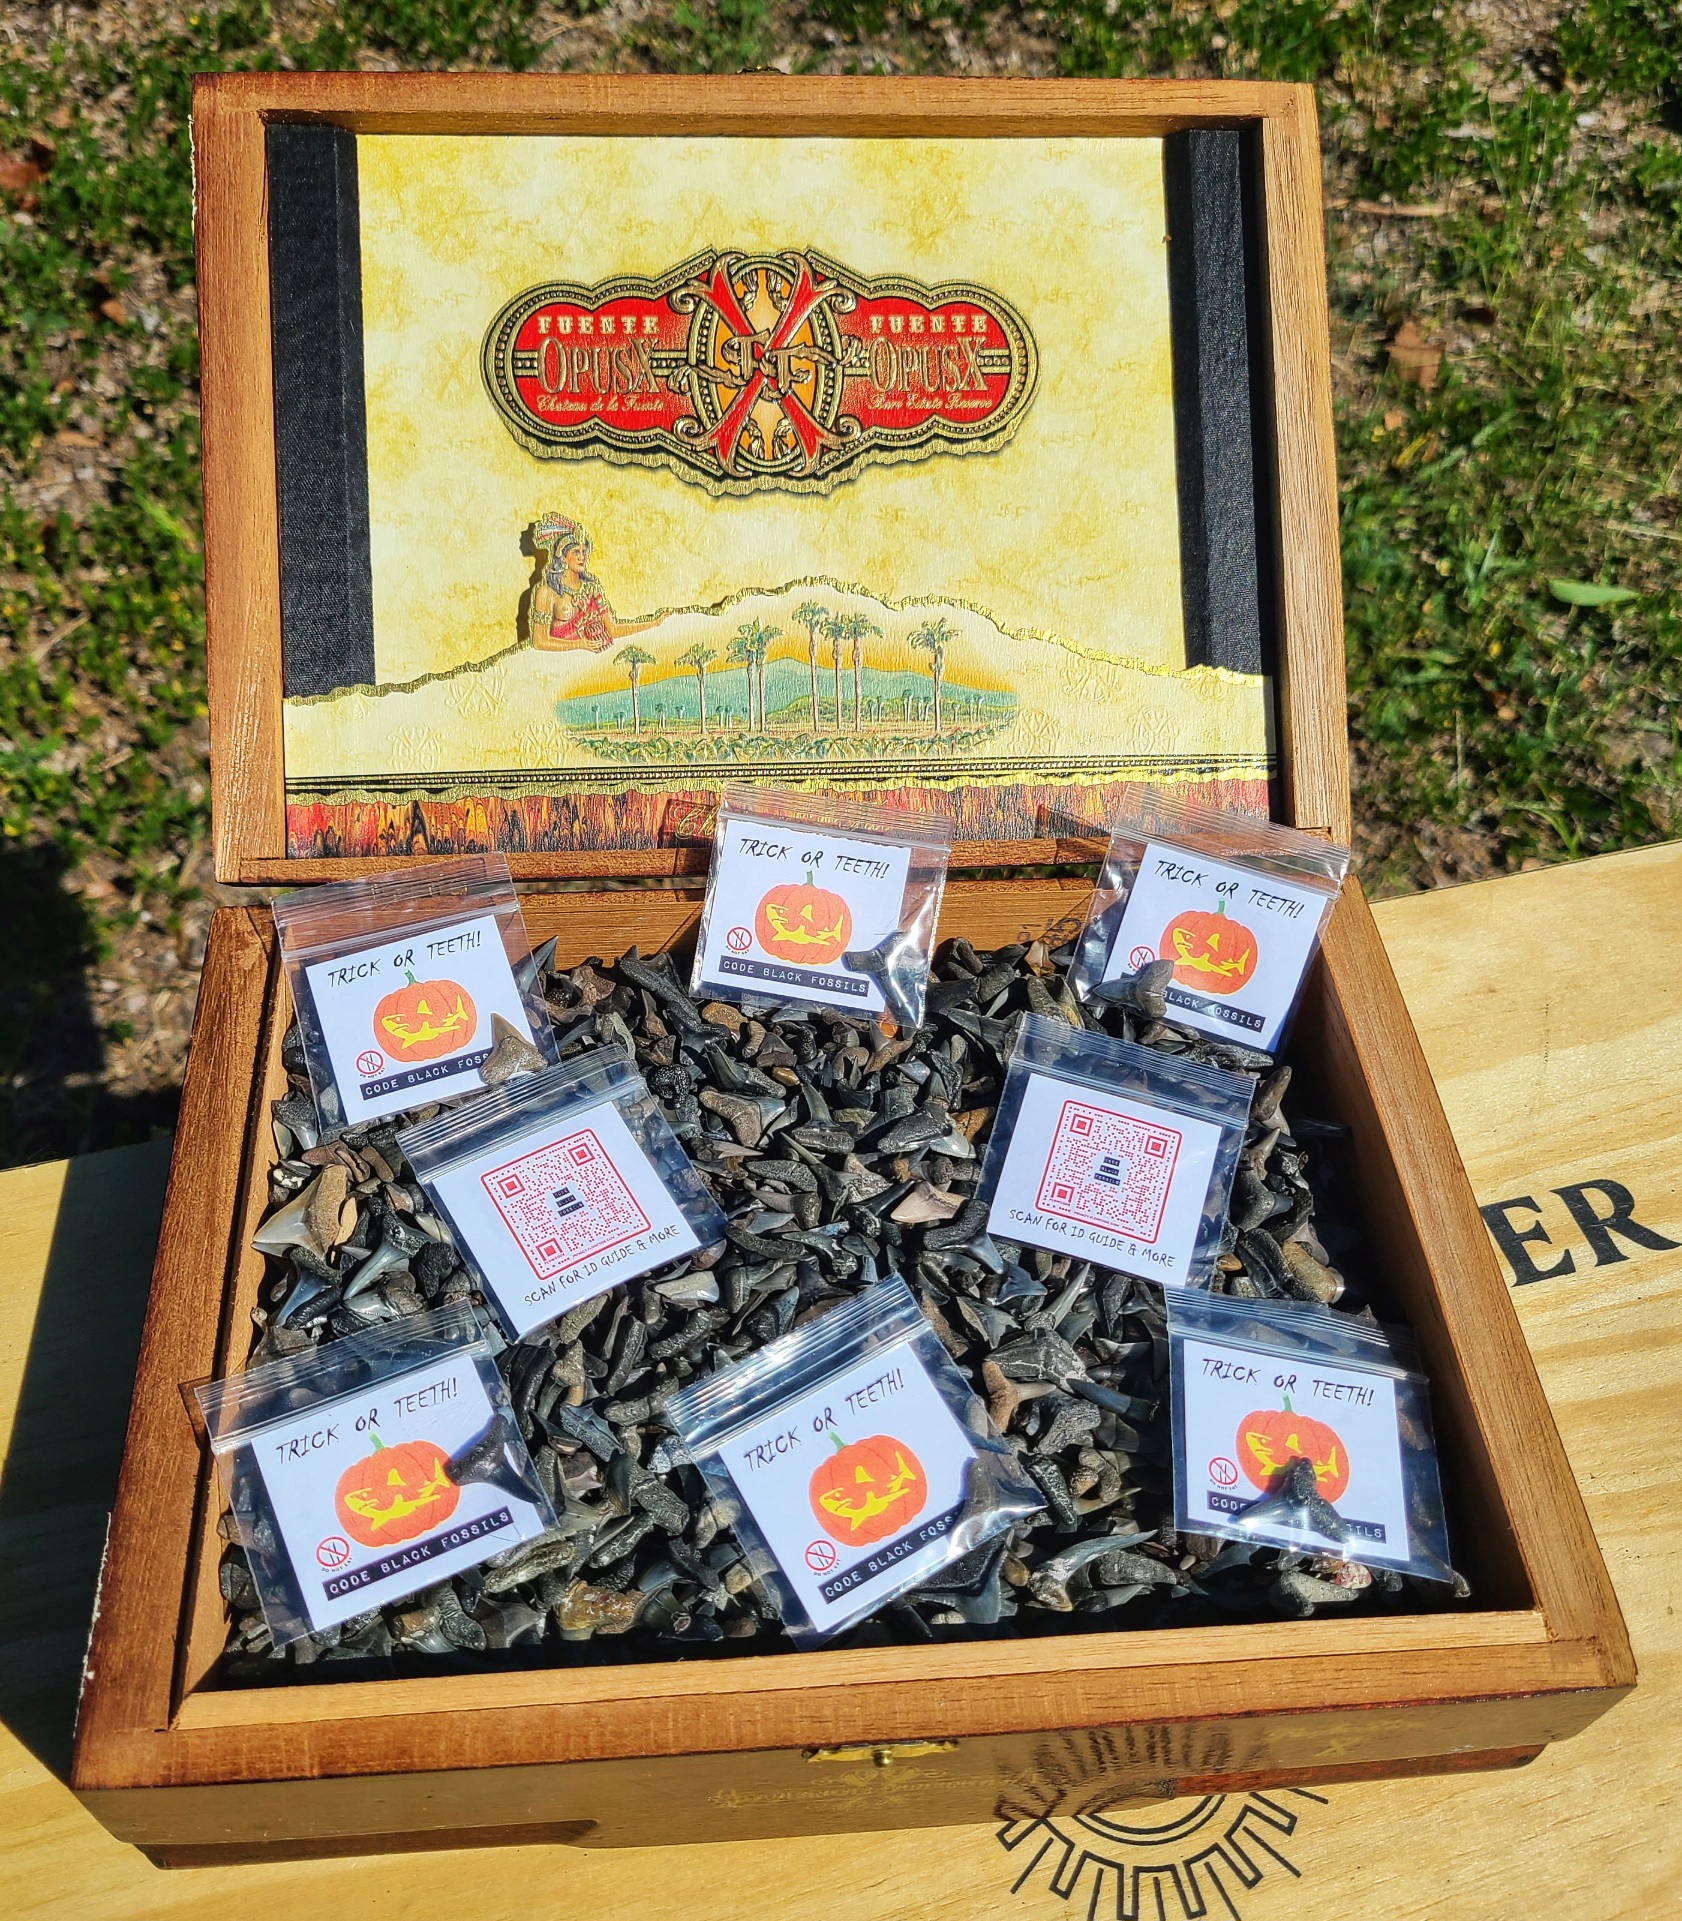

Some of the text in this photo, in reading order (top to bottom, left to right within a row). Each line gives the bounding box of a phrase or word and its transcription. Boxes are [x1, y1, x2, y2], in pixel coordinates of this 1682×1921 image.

[537, 315, 659, 334] FUENTE
[869, 314, 987, 333] FUENTE
[741, 838, 890, 879] TRICK OR TEETH!
[1155, 860, 1305, 919] TRICK OR TEETH!
[328, 931, 481, 988] TRICK OR TEETH!
[723, 961, 867, 993] CODE BLACK FOSSILS
[1209, 1003, 1262, 1028] OSSILS
[365, 1079, 399, 1096] CODE
[407, 1065, 449, 1084] BLACK
[524, 1224, 680, 1306] SCAN FOR ID GUIDE & MORE
[1009, 1209, 1176, 1267] SCAN FOR ID GUIDE & MORE
[1202, 1359, 1375, 1407] TRICK OR TEETH!
[276, 1377, 459, 1464] TRICK OR TEETH!
[743, 1368, 905, 1471] TRICK OR TEETH!
[329, 1512, 510, 1595] CODE BLACK FOSSILS
[824, 1515, 953, 1598] CODE BLACK FOSS
